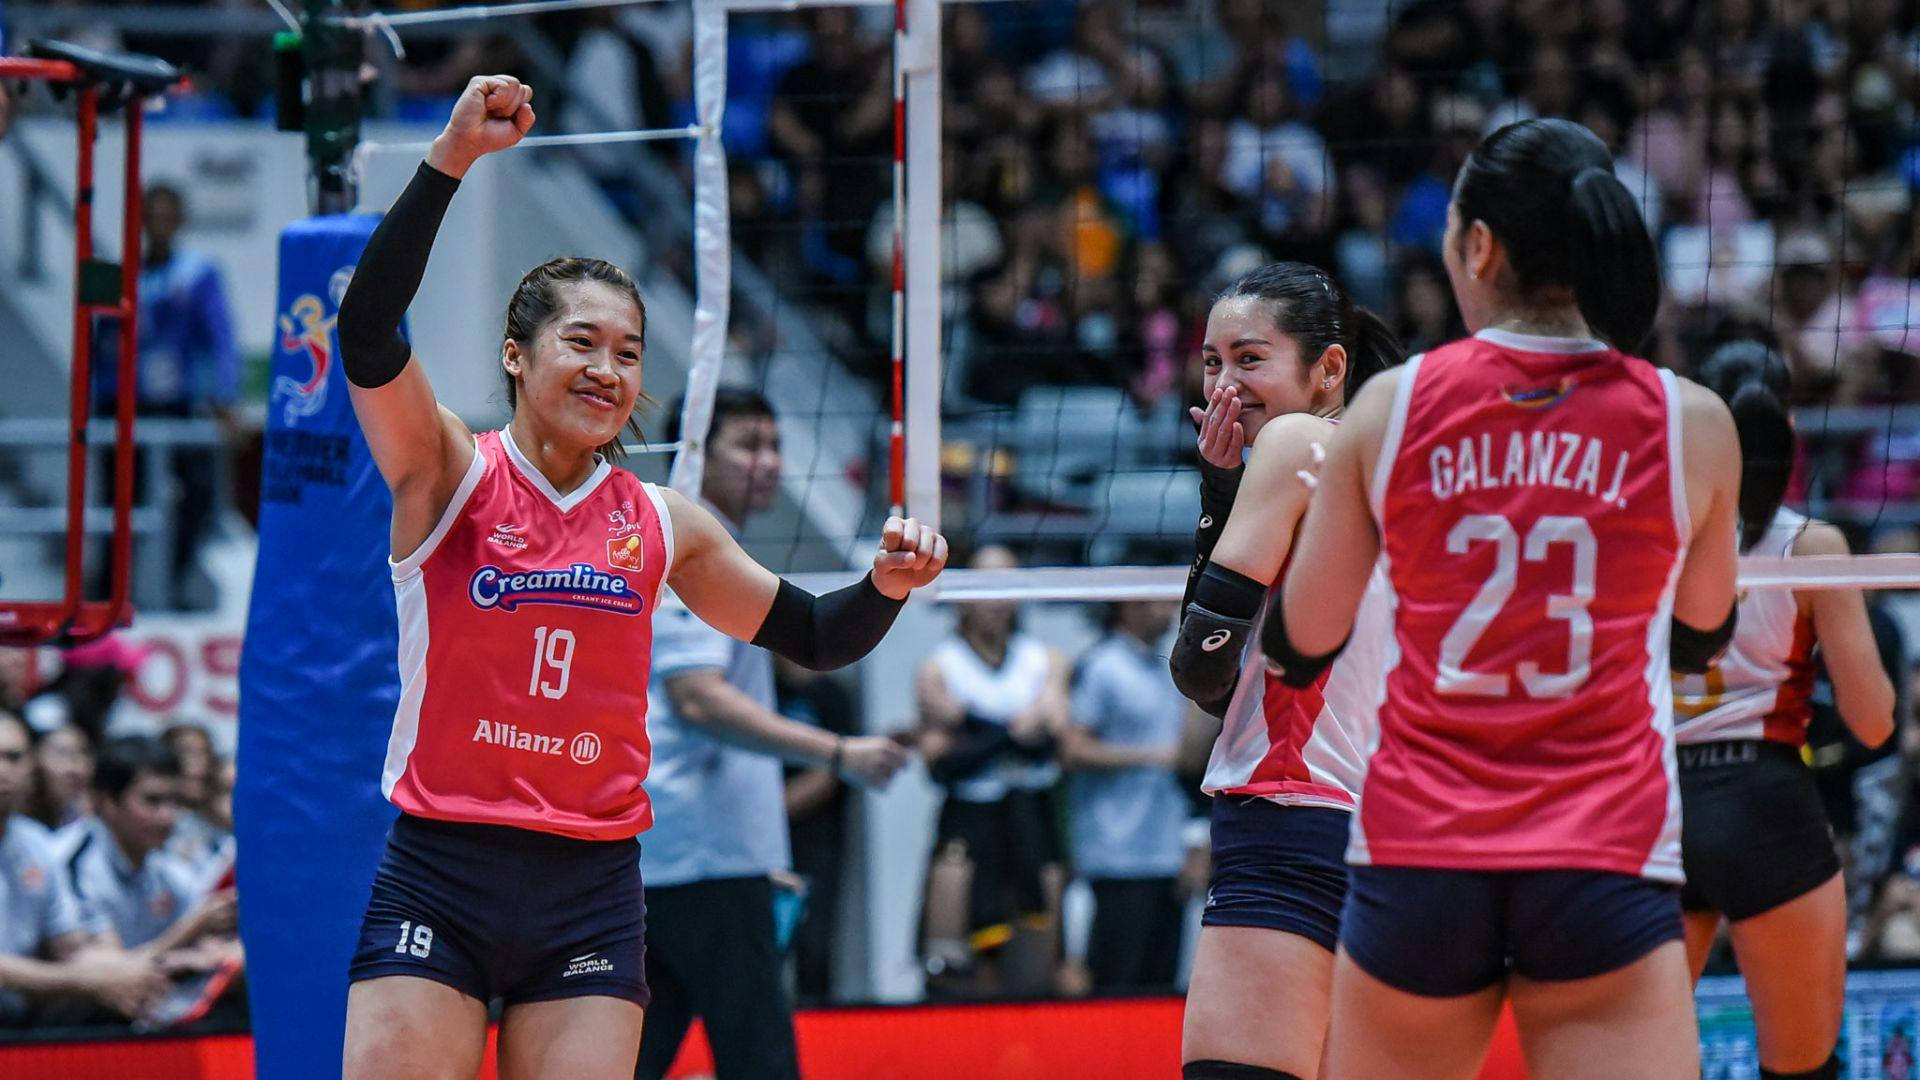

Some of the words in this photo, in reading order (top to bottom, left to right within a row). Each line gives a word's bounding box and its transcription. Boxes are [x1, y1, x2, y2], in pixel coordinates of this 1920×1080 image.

[1430, 430, 1602, 500] GALANZA
[1602, 450, 1630, 509] J.
[487, 536, 529, 549] BALANCE
[493, 531, 525, 543] WORLD
[472, 565, 625, 606] Creamline
[613, 600, 633, 608] CREAM
[1435, 514, 1598, 698] 23
[528, 626, 576, 700] 19
[472, 718, 566, 756] Allianz
[395, 920, 434, 959] 19
[563, 964, 614, 978] BALANCE
[569, 958, 608, 970] WORLD
